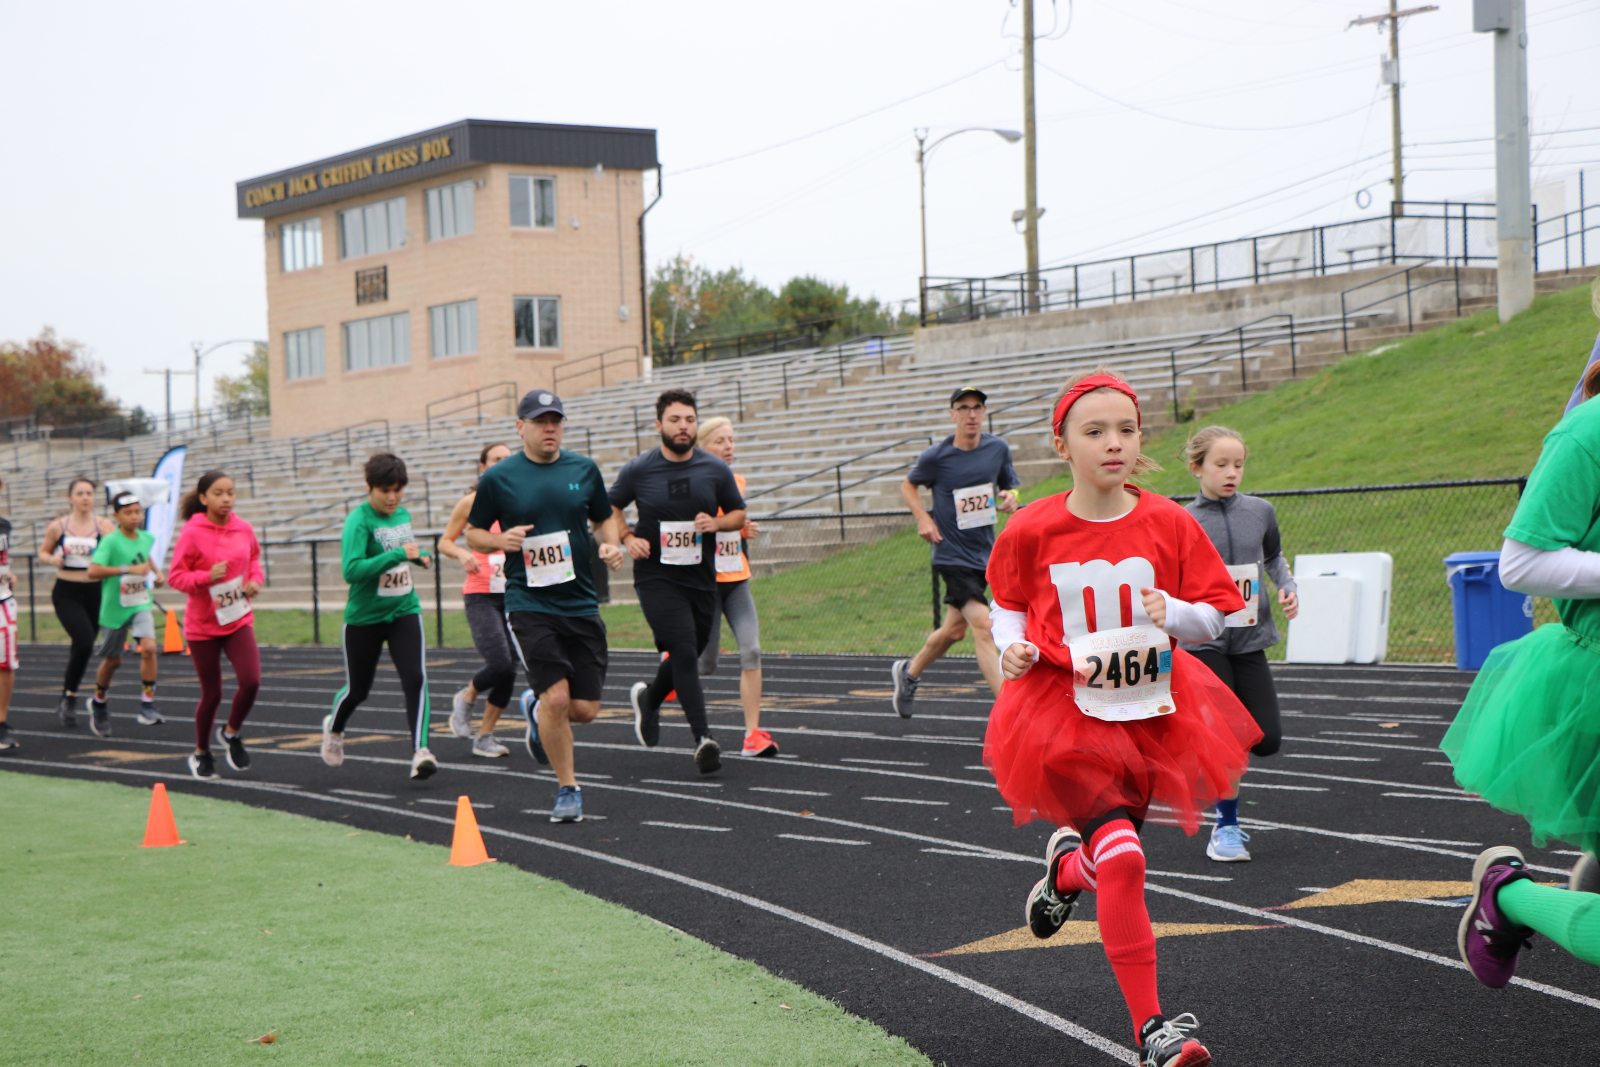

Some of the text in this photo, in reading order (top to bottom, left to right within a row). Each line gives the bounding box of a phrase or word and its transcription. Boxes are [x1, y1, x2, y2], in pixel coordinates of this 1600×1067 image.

[245, 137, 451, 207] COACH JACK GRIFFIN PRESS BOX
[962, 494, 990, 513] 2522
[666, 532, 697, 548] 2564
[528, 544, 565, 567] 2481
[1090, 633, 1148, 650] HEADLESS
[1085, 646, 1159, 689] 2464
